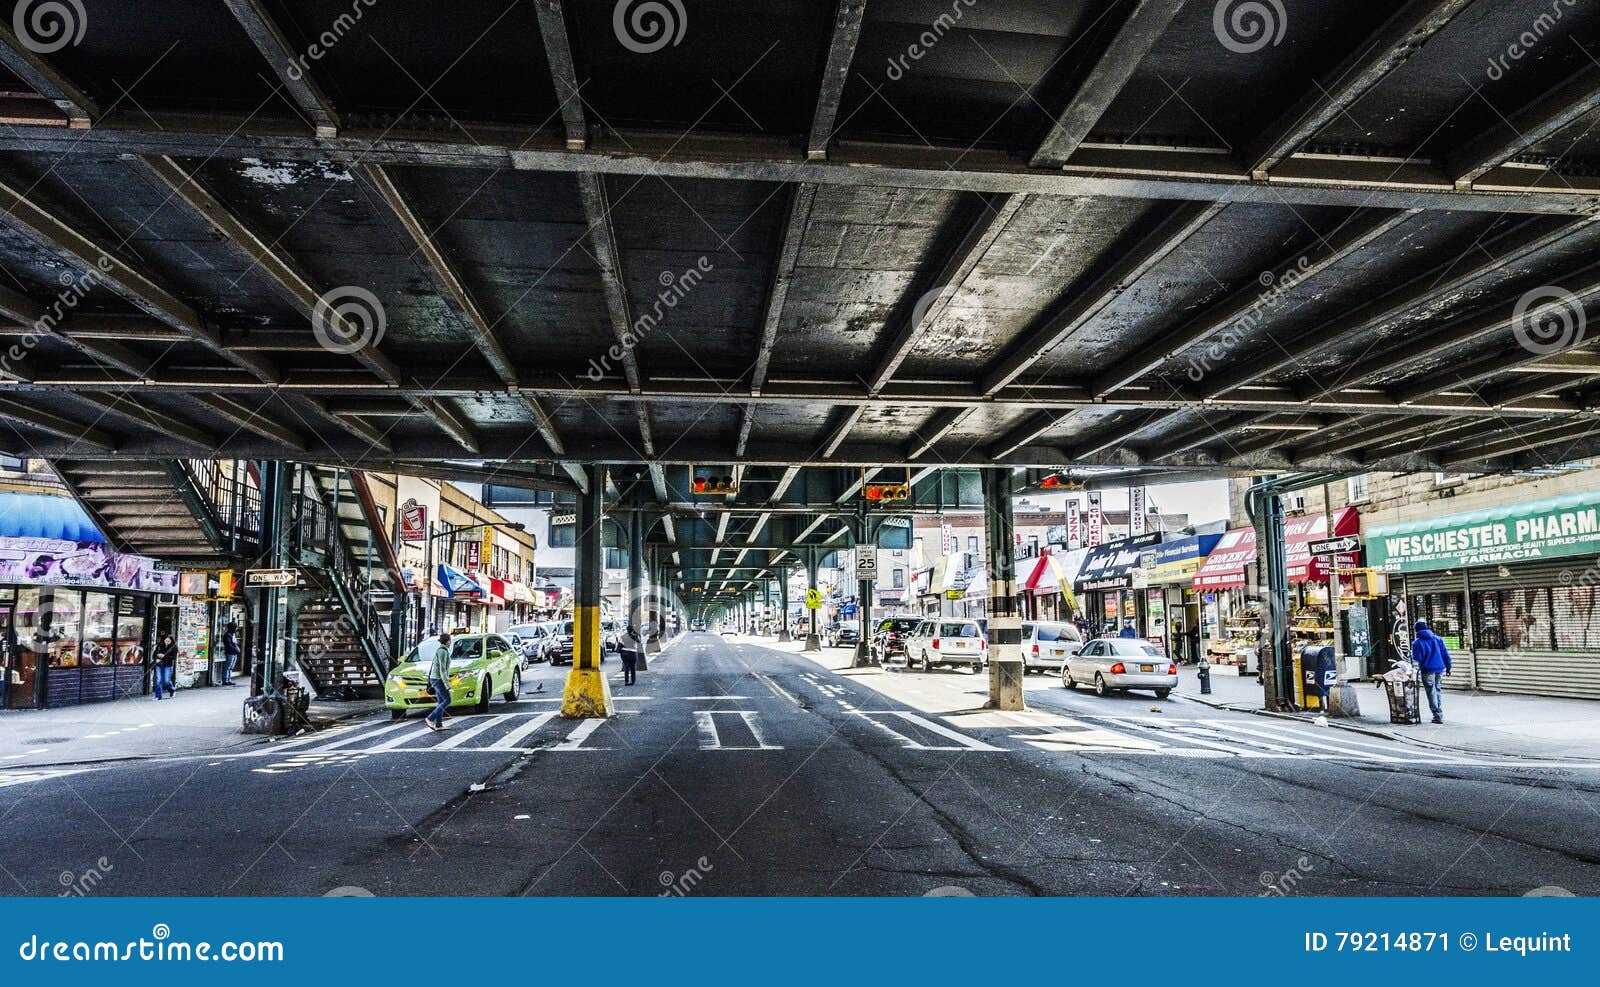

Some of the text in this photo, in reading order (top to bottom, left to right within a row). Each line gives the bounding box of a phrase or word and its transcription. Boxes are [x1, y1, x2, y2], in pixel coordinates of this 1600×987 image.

[1068, 501, 1079, 541] PIZZA
[1090, 508, 1100, 546] CHICKEN
[1385, 509, 1600, 557] WESCHESTER PHARM
[1315, 543, 1331, 552] ONE
[1336, 540, 1352, 549] WAY
[858, 559, 875, 568] 25
[1460, 548, 1542, 564] FARMACIA
[273, 573, 289, 581] WAY
